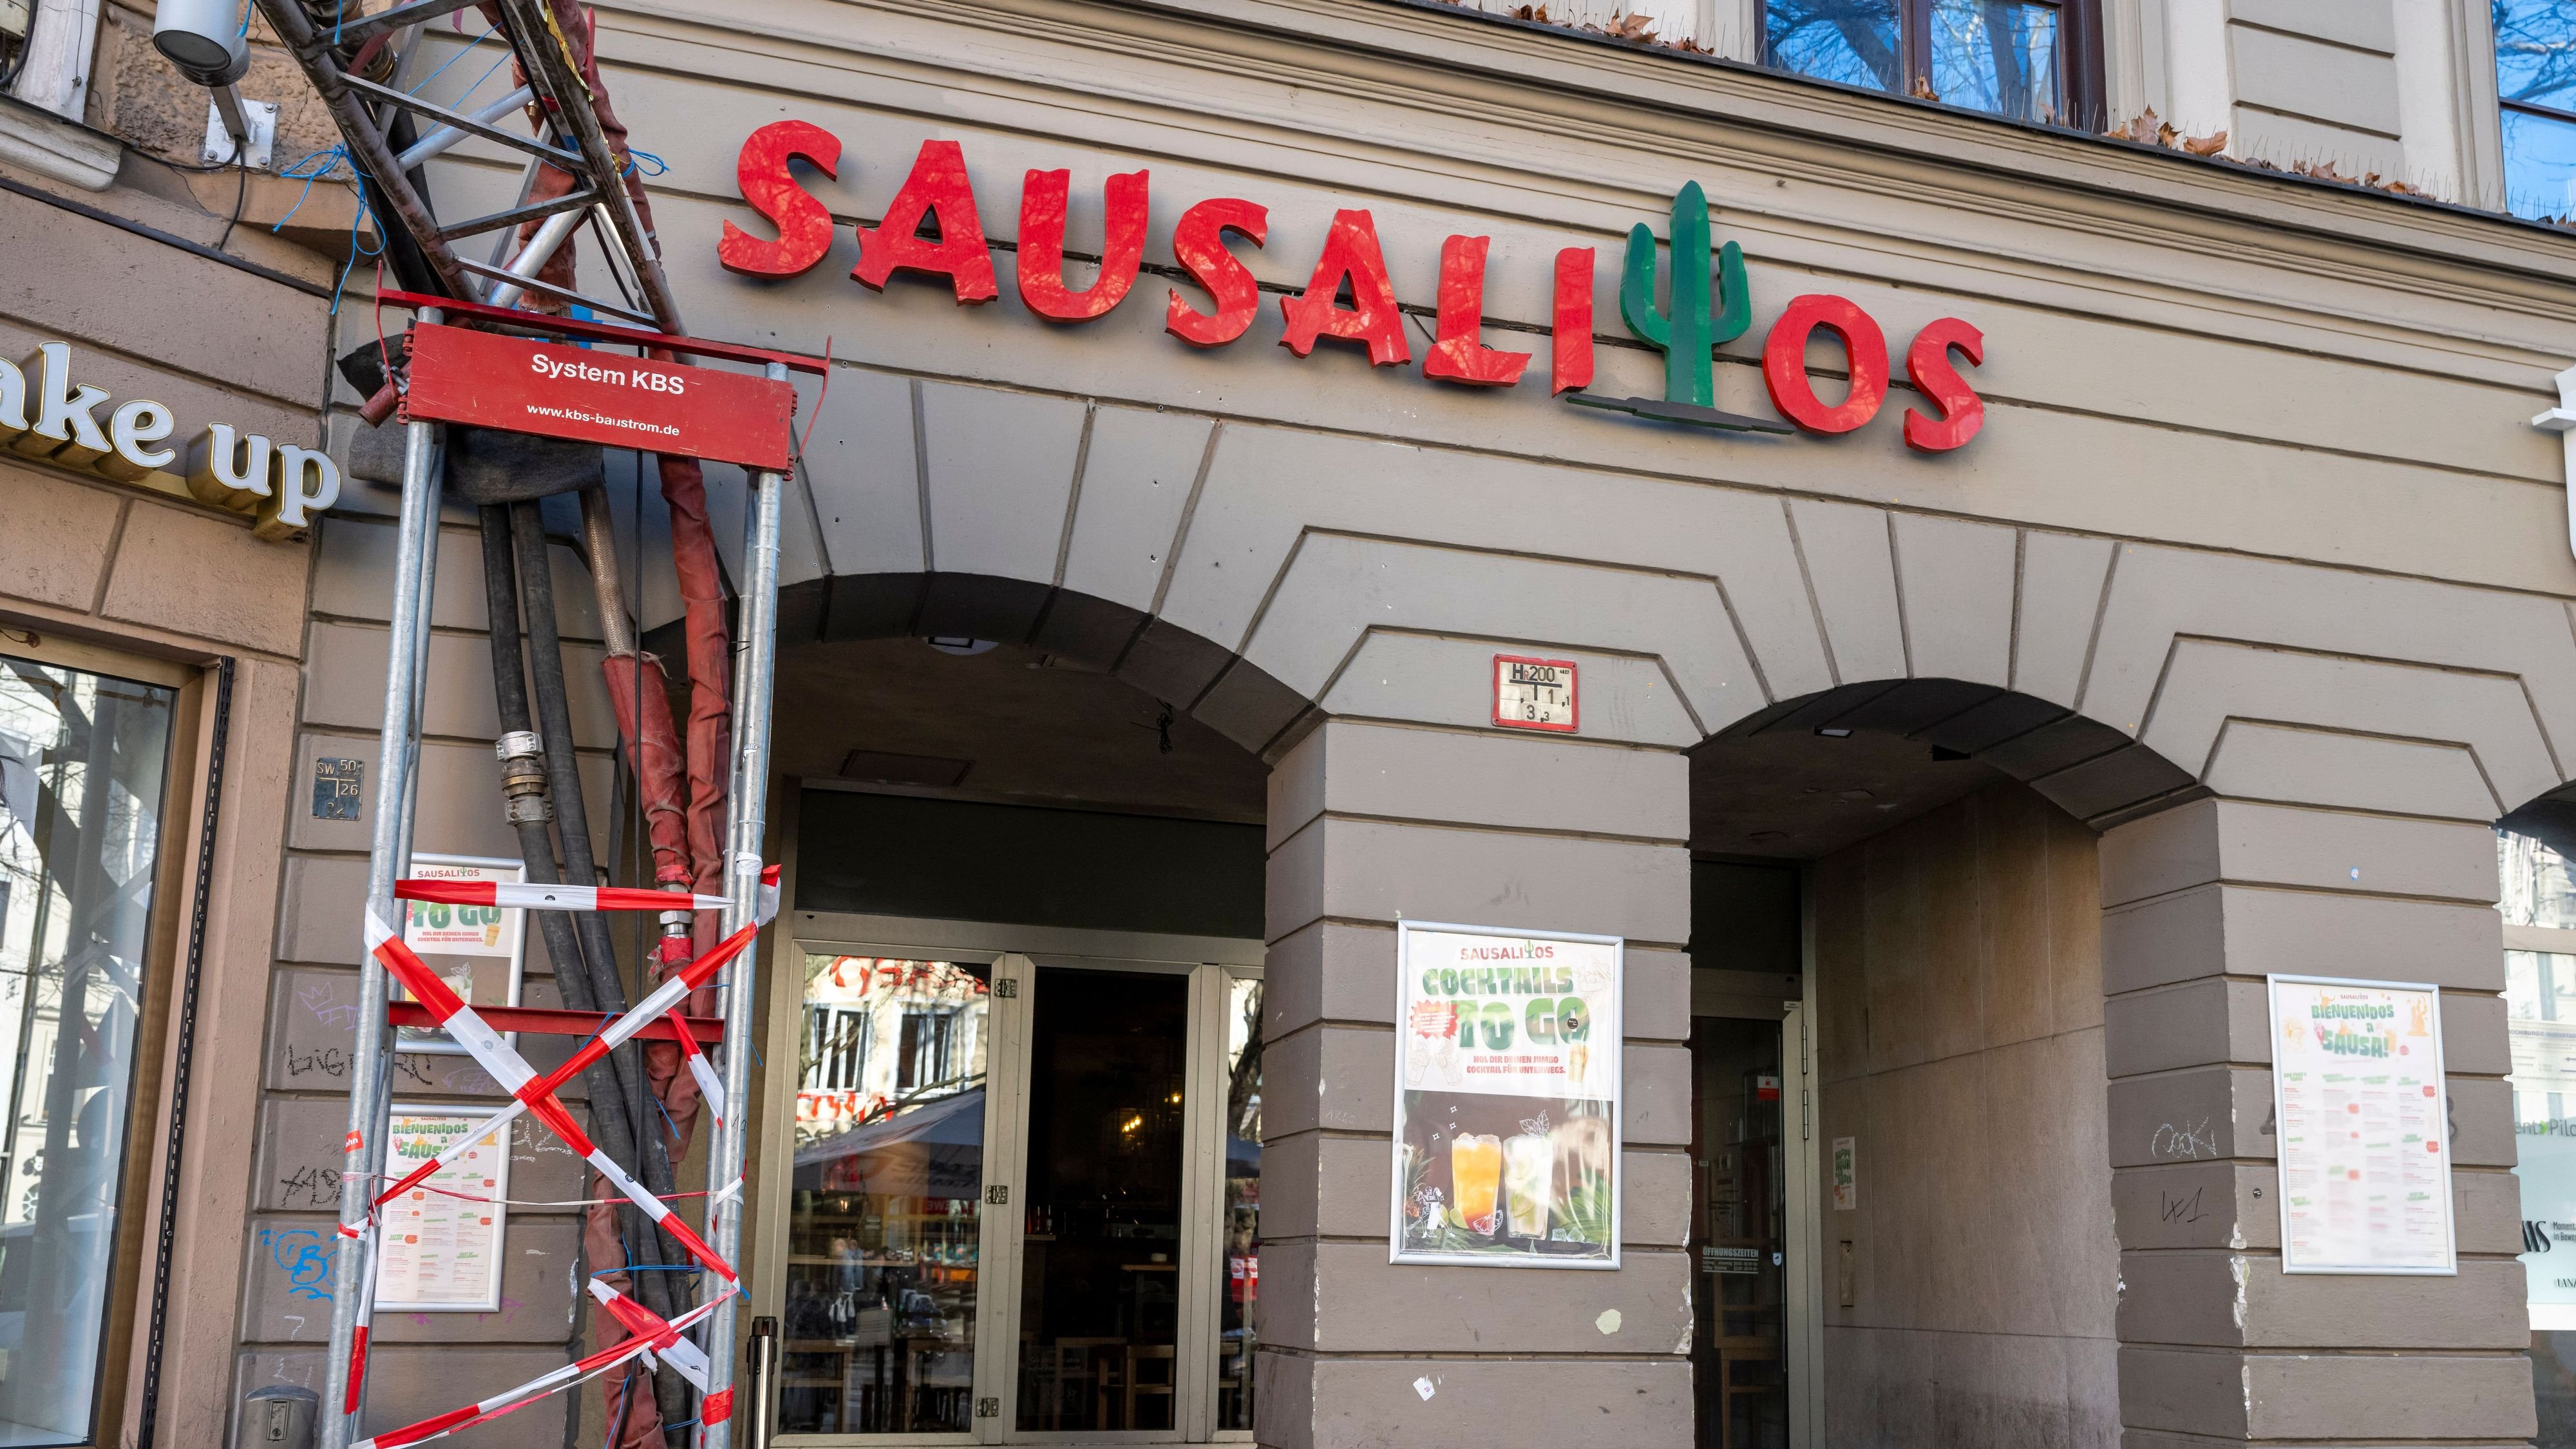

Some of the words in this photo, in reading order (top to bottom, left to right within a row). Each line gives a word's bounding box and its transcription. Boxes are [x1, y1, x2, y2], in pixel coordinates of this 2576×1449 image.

[531, 353, 625, 386] System
[631, 369, 685, 395] KBS
[526, 404, 681, 437] www.kbs-baustrom.de
[209, 422, 341, 528] up
[317, 762, 335, 774] SW
[340, 759, 356, 772] 50
[340, 784, 358, 795] 26
[1422, 967, 1573, 996] COCKTAILS
[2311, 1003, 2394, 1019] BIENVENIDOS
[1451, 999, 1515, 1050] TO
[1525, 997, 1591, 1045] GO
[2366, 1023, 2374, 1032] a
[2322, 1030, 2389, 1058] SAUSA!
[1503, 1064, 1517, 1074] FÜR
[393, 1123, 468, 1134] BIENVENIDOS
[1703, 1245, 1759, 1258] ÖFFNUNGSZEITEN
